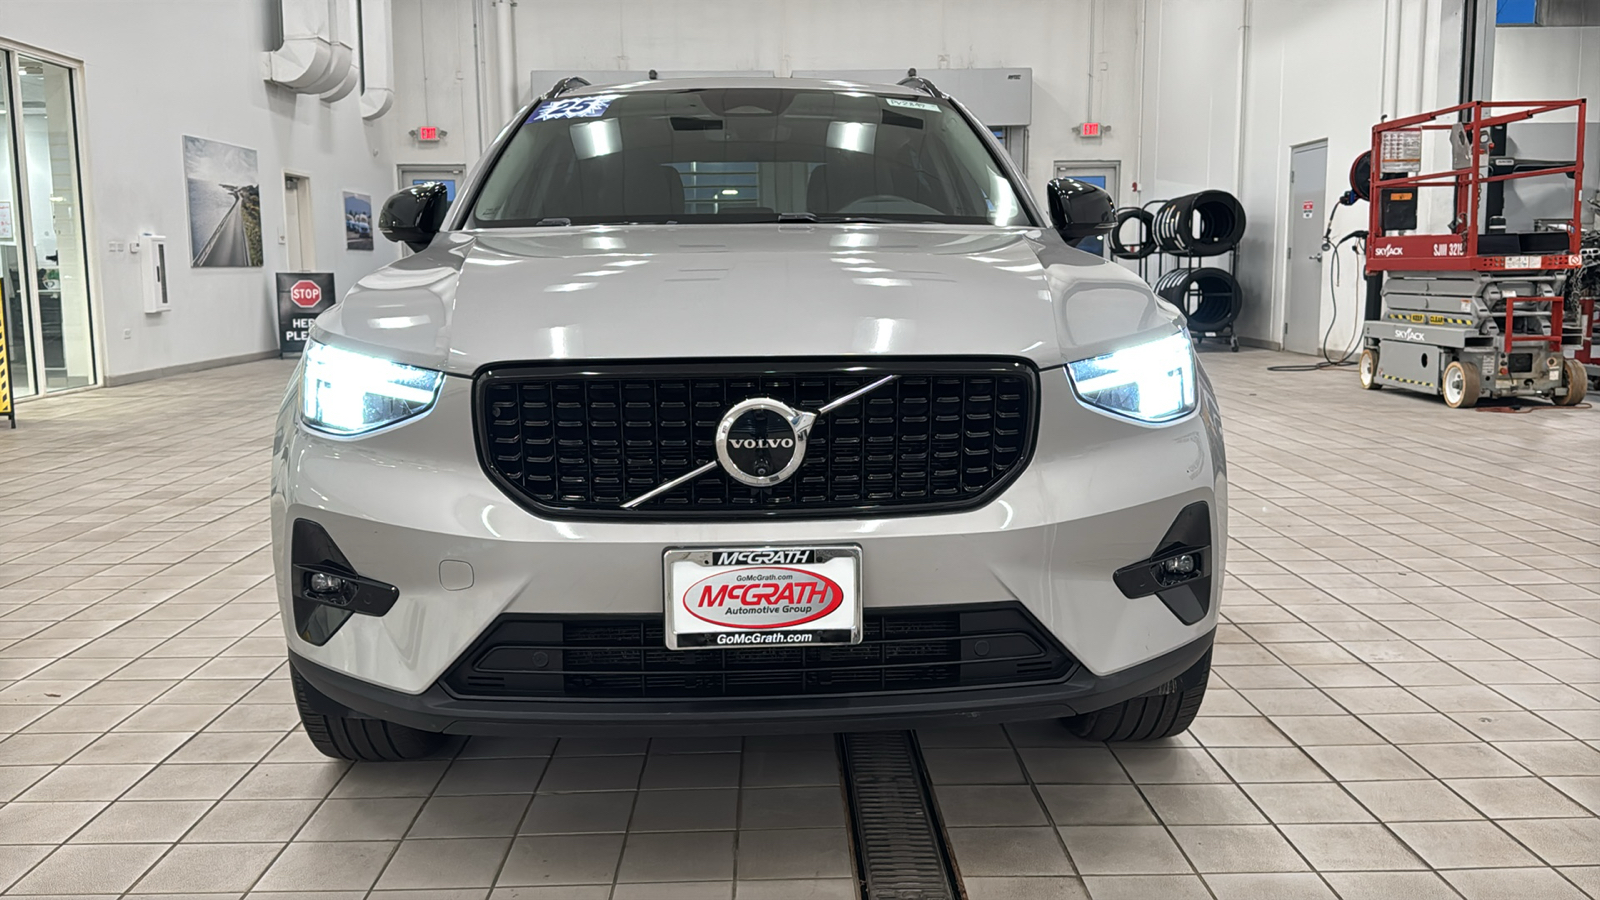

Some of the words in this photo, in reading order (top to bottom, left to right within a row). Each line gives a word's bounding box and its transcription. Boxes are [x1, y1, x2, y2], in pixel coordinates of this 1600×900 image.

[548, 99, 596, 115] 25
[421, 126, 437, 140] EXIT
[1083, 122, 1099, 136] EXIT
[1375, 243, 1403, 257] SKYJACK
[293, 288, 319, 299] STOP
[293, 318, 316, 328] HER
[286, 331, 310, 341] PLE
[1394, 328, 1425, 341] SKYJACK
[729, 438, 793, 449] VOLVO
[736, 574, 793, 582] GoMcGrath.com
[725, 605, 780, 615] Automotive
[782, 605, 812, 615] Group
[716, 633, 812, 645] GoMcGrath.com
